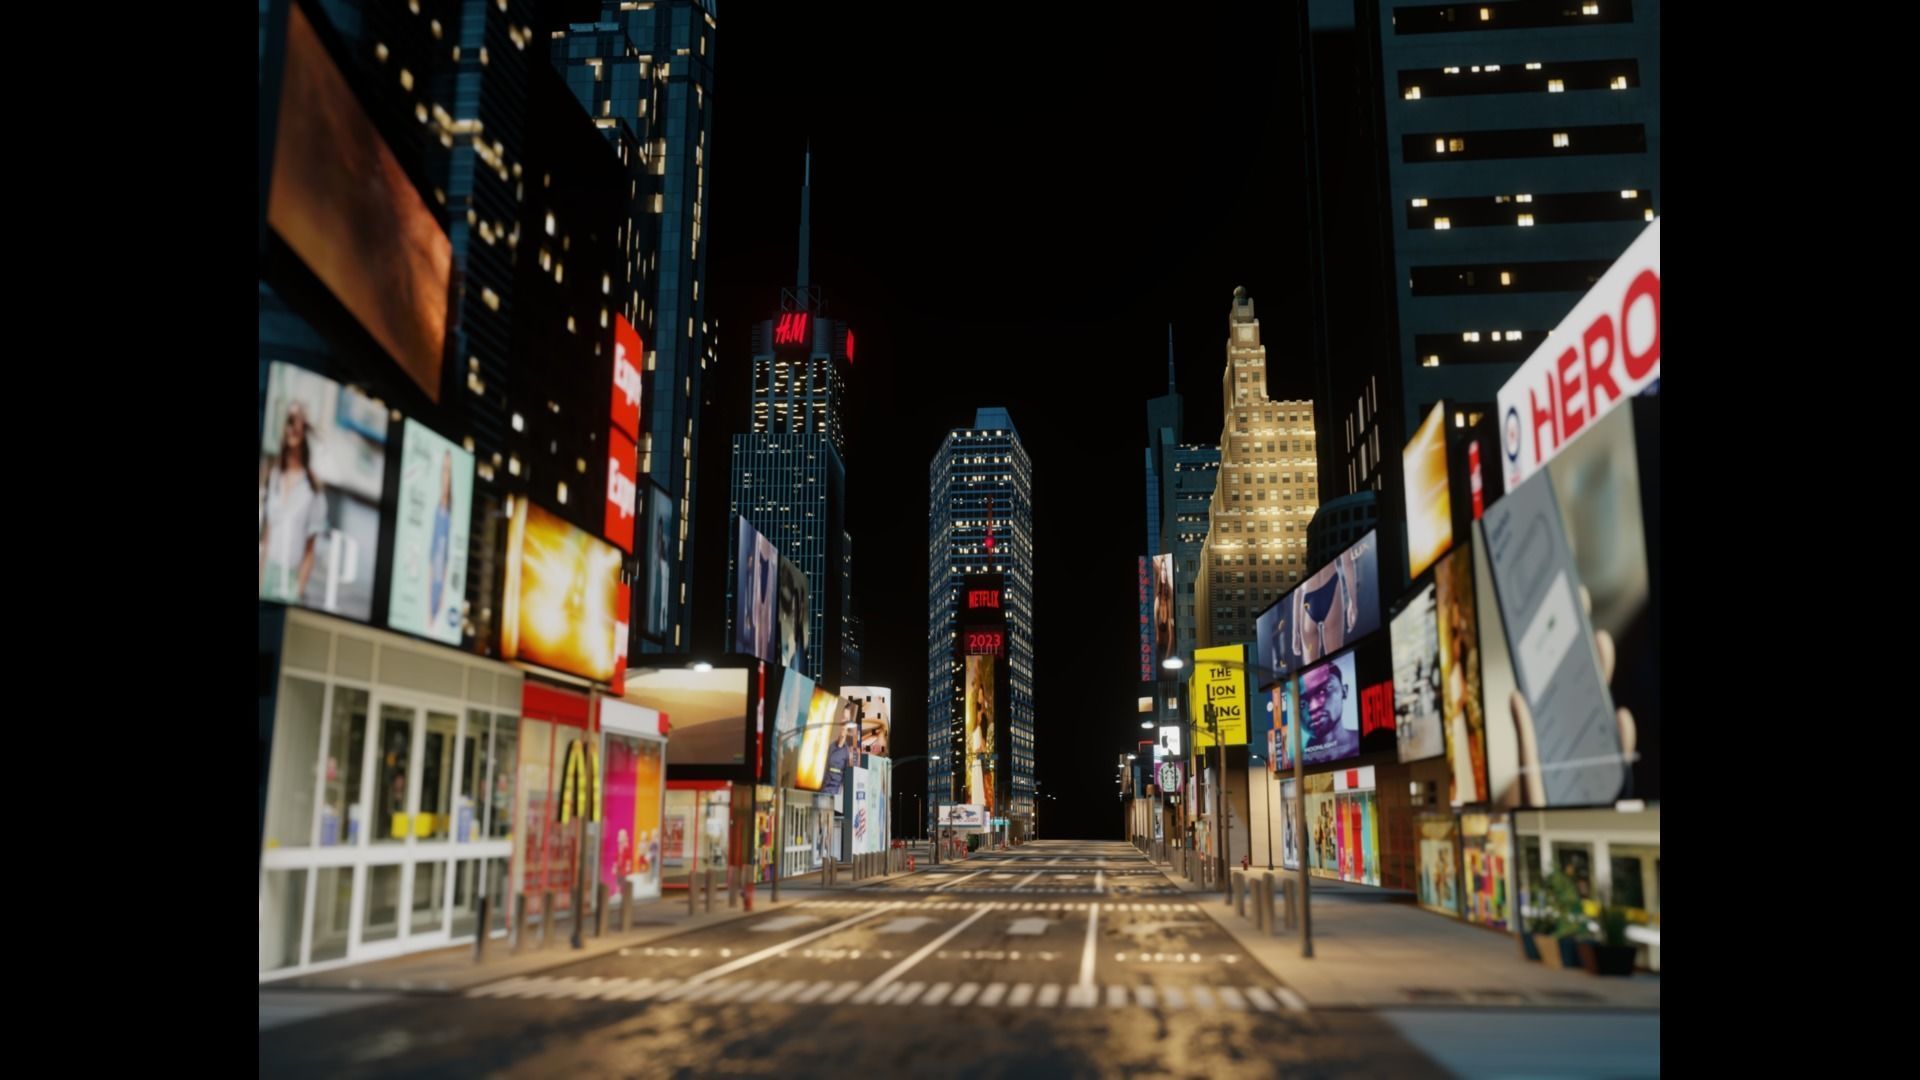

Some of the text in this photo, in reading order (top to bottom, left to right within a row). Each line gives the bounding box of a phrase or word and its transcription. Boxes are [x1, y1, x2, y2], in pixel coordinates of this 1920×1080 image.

[775, 312, 808, 345] H&M
[1529, 267, 1660, 464] HERO
[968, 590, 1000, 609] NETFLIX
[969, 634, 1001, 648] 2023
[1210, 667, 1232, 679] THE
[1206, 683, 1236, 702] LION
